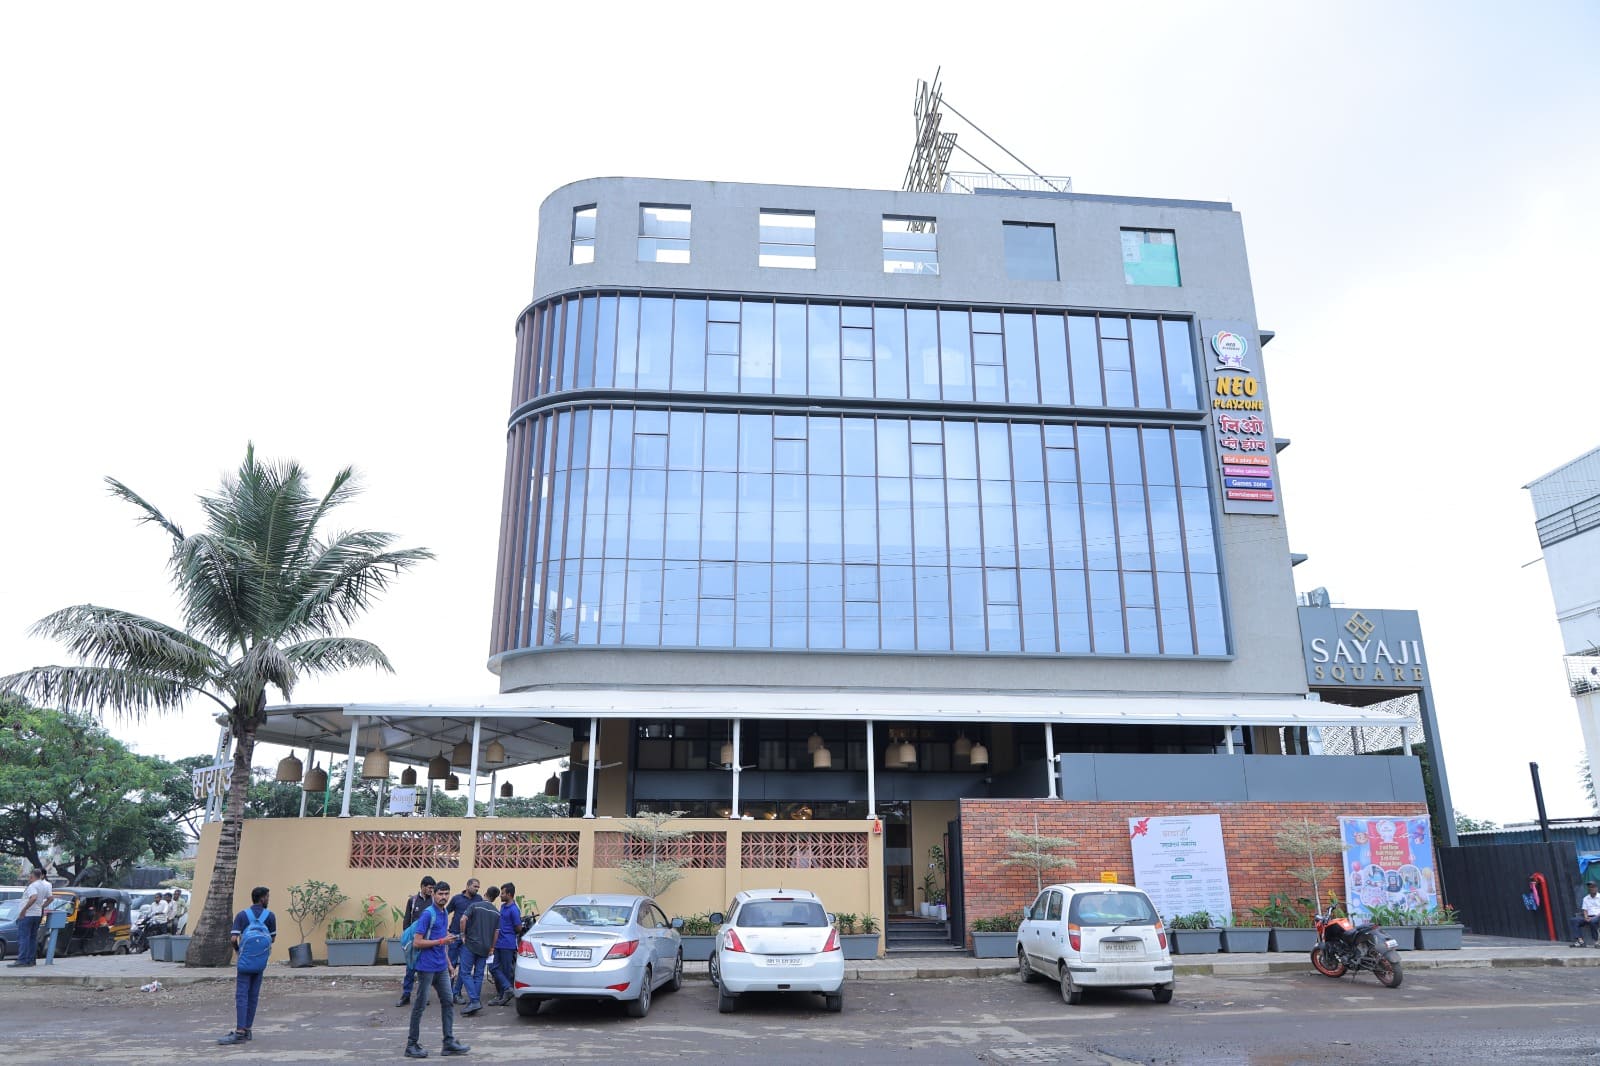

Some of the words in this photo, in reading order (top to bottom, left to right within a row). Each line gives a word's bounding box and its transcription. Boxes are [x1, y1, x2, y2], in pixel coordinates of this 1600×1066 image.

[1217, 376, 1257, 396] NEO
[1214, 398, 1264, 410] PLAYZONE
[1220, 415, 1264, 433] निओ
[1241, 438, 1266, 450] झोन
[1232, 479, 1252, 487] Games
[1311, 638, 1422, 665] SAYAJI
[1314, 665, 1424, 683] SQUARE
